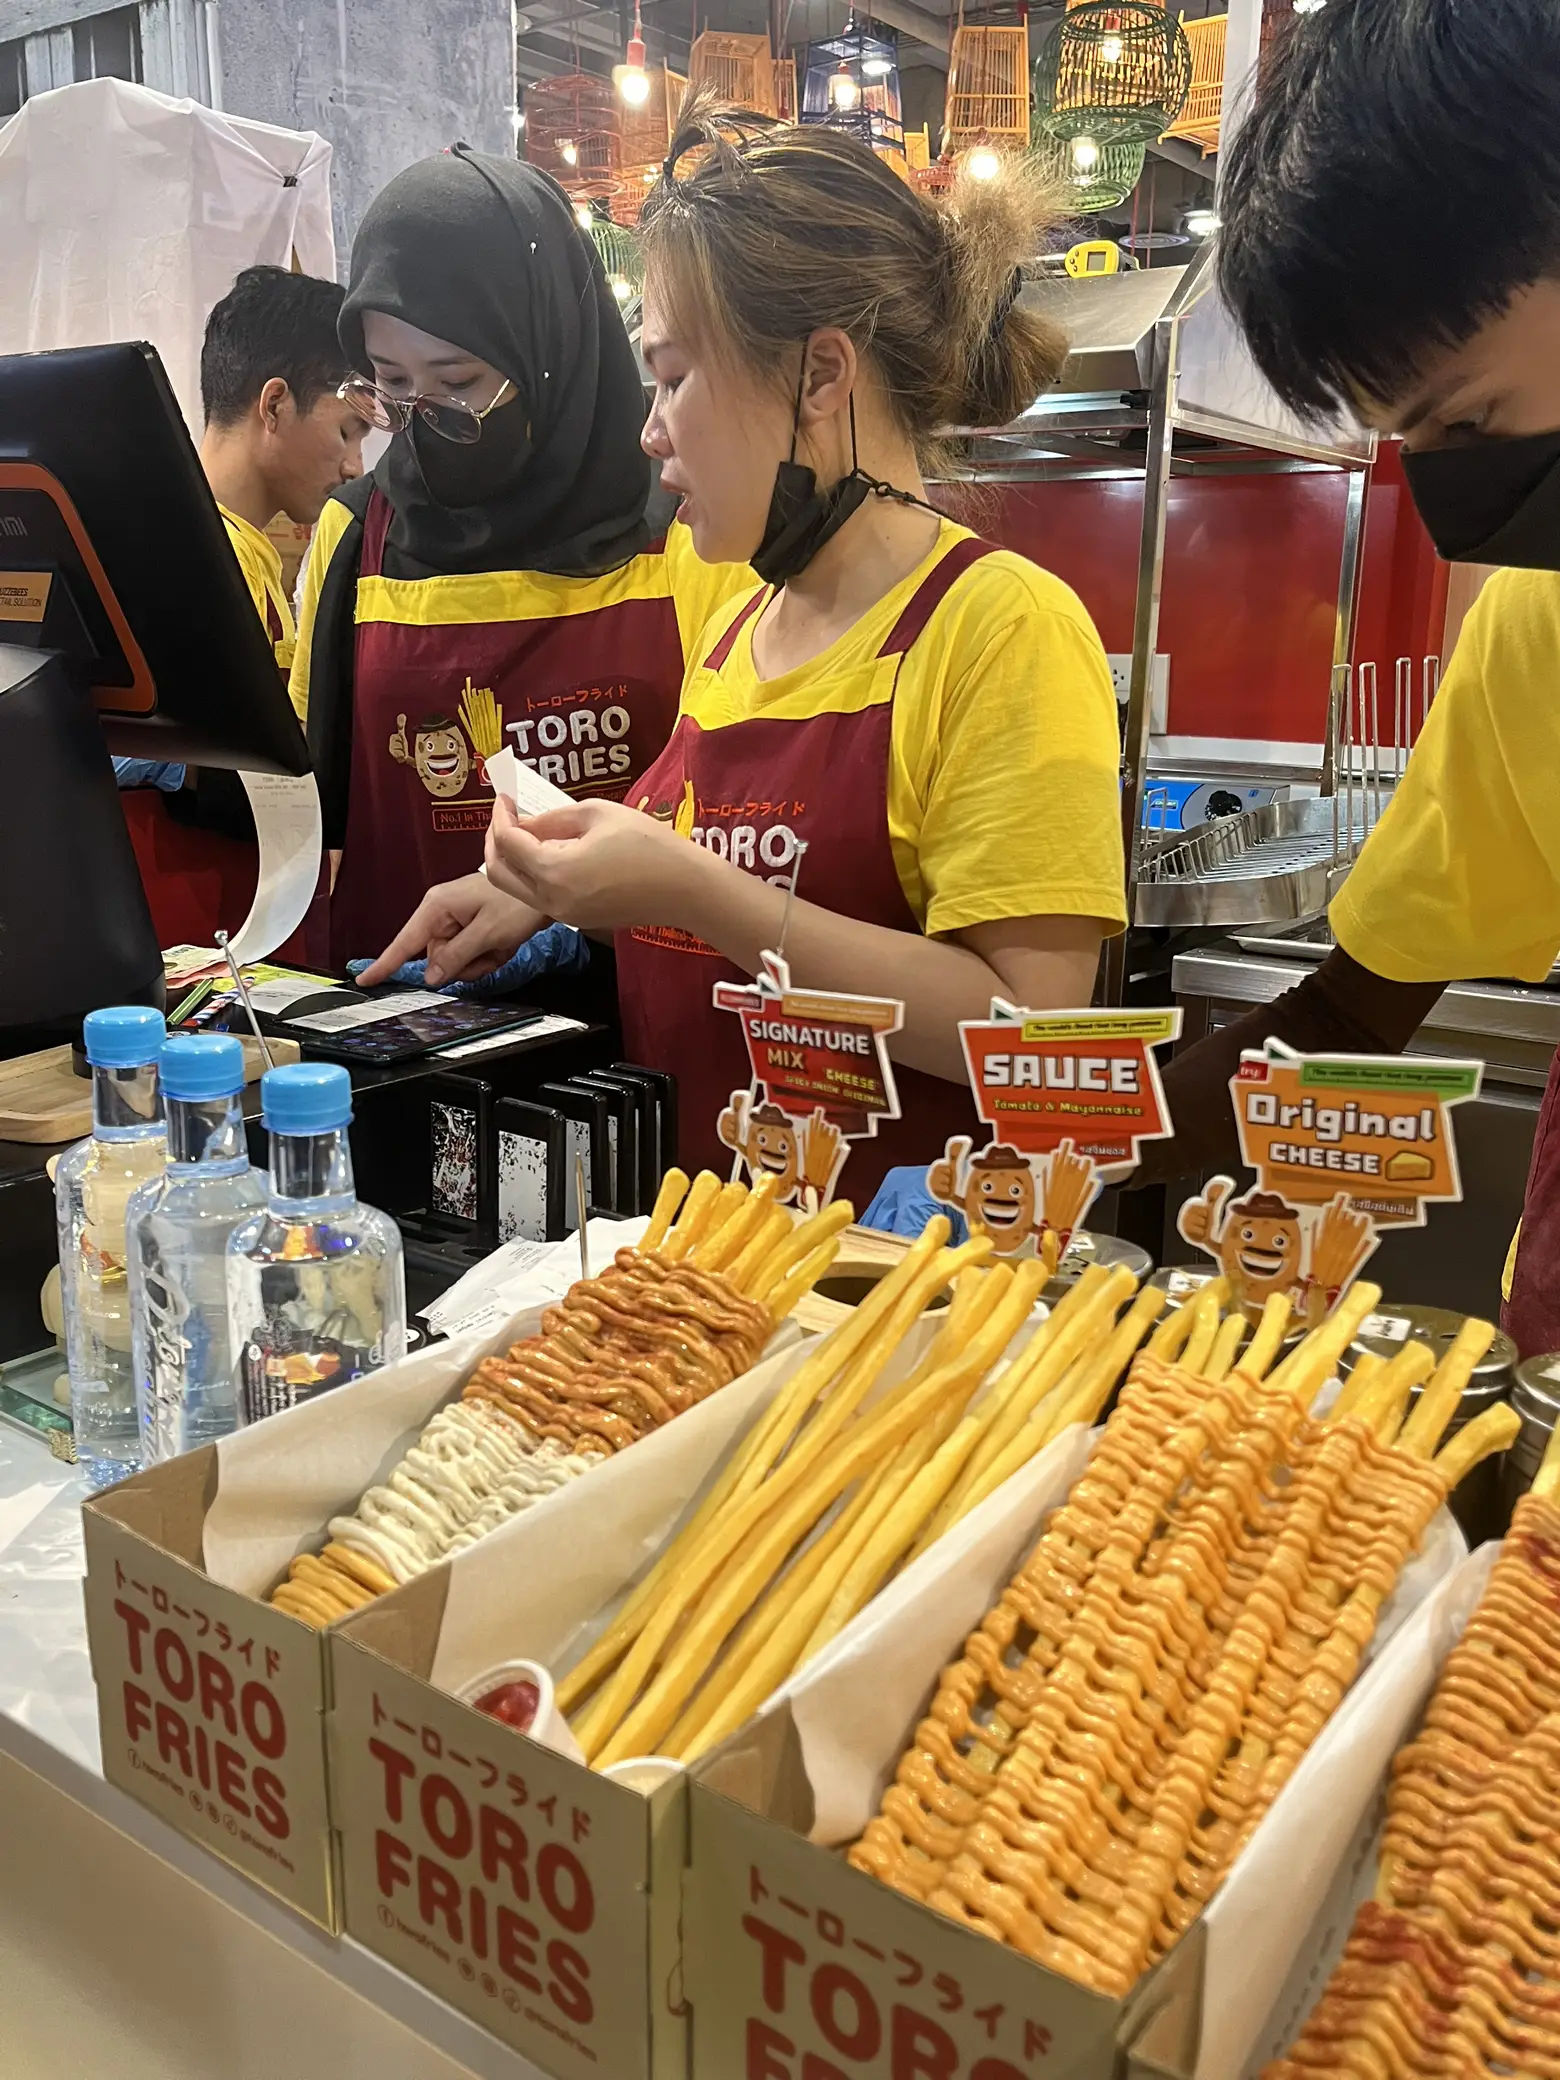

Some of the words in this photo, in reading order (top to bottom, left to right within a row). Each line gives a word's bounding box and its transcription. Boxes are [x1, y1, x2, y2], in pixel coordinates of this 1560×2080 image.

[505, 705, 631, 754] TORO
[749, 1019, 871, 1055] SIGNATURE
[767, 1047, 805, 1070] MIX
[825, 1068, 876, 1091] CHEESE
[983, 1053, 1140, 1094] SAUCE
[993, 1099, 1041, 1112] Tomato
[1246, 1092, 1436, 1142] Original
[1269, 1142, 1382, 1175] CHEESE
[114, 1558, 281, 1680] トーローフライド
[113, 1597, 287, 1760] TORO
[122, 1680, 291, 1841] FRIES
[372, 1692, 592, 1844] トーローフライド
[368, 1736, 596, 1935] TORO
[375, 1828, 594, 2026] FRIES
[750, 1864, 1053, 2062] トーローフライド
[741, 1914, 1031, 2080] TOR
